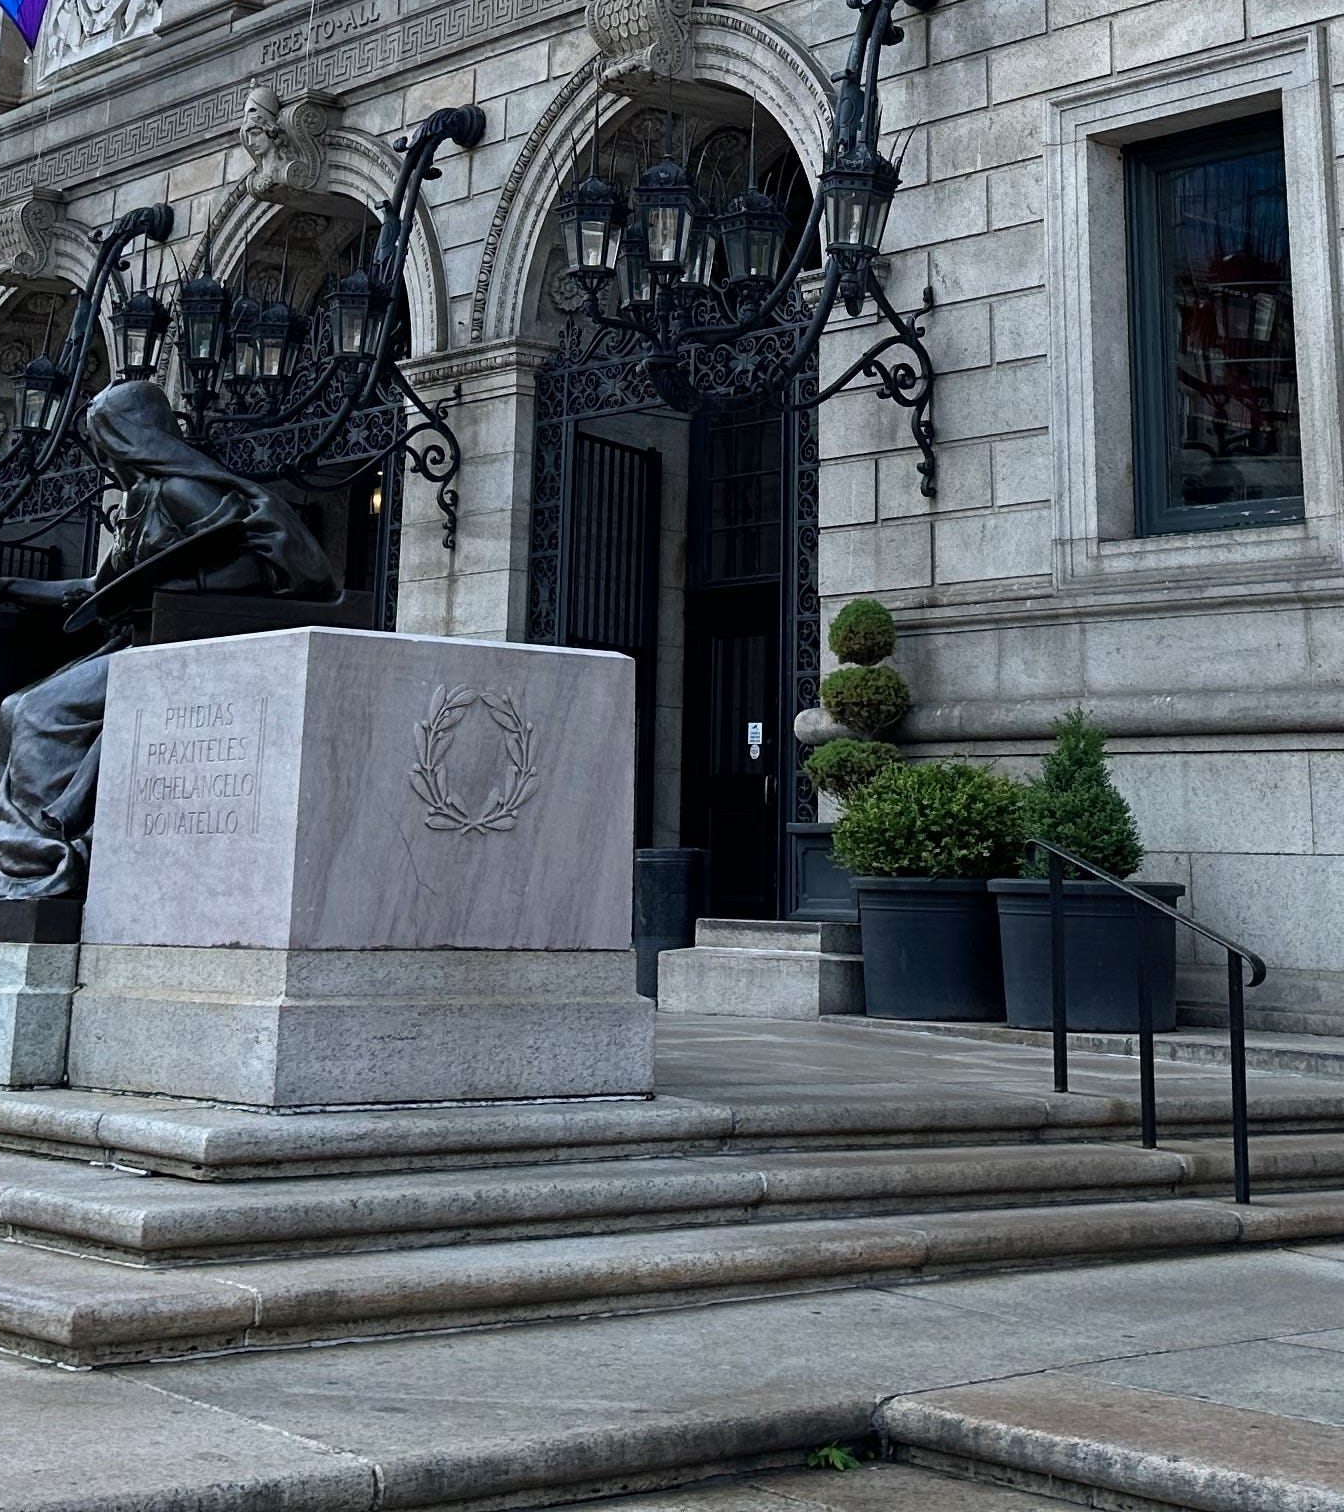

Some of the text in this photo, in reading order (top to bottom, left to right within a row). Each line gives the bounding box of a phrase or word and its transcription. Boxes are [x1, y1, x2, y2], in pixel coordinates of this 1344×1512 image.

[165, 702, 234, 730] PHIDIAS
[148, 737, 248, 765] PRAXITELES
[136, 773, 254, 801] MICHELANGELO
[144, 810, 238, 836] DONATELLO
